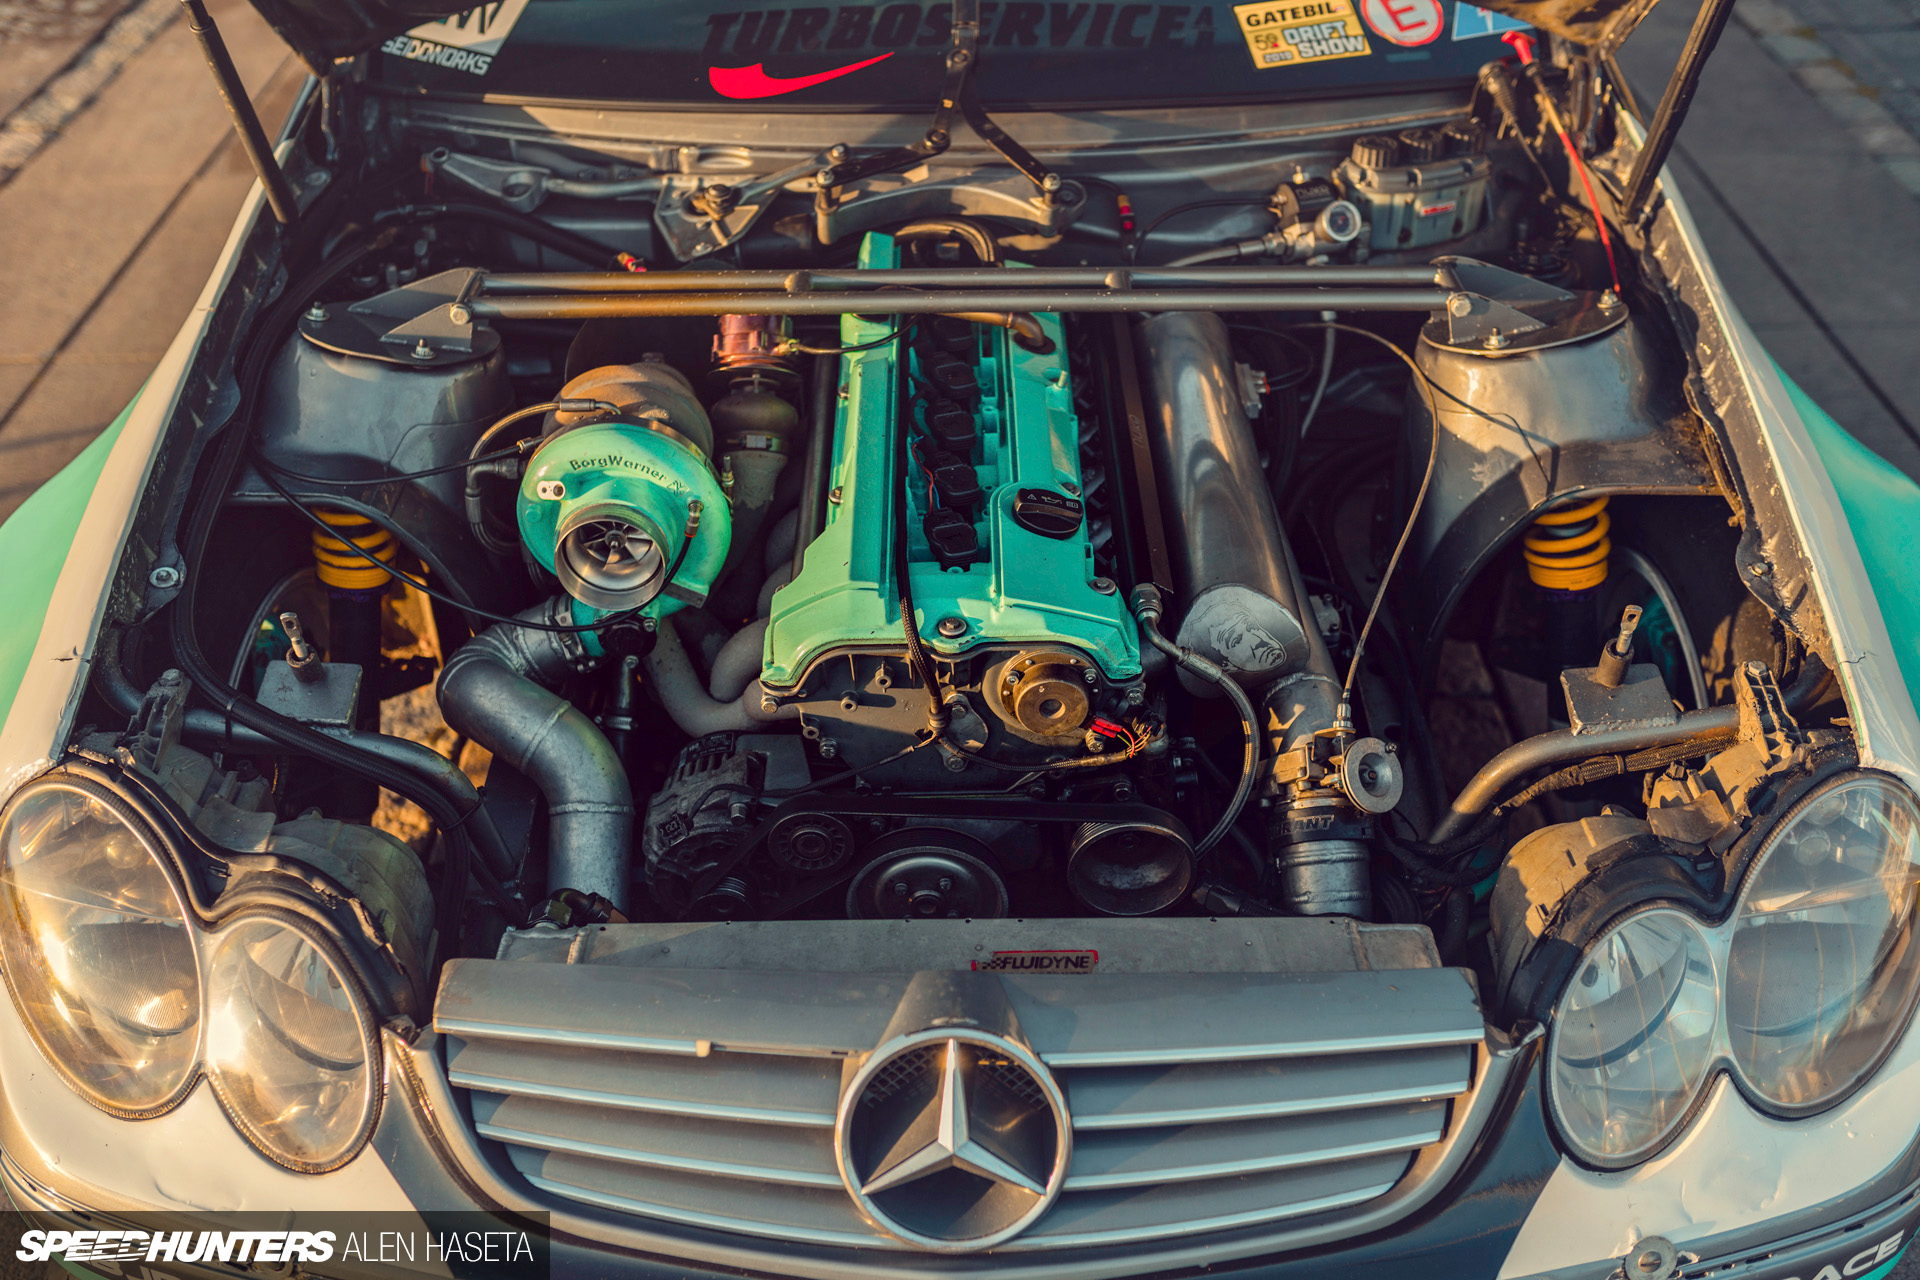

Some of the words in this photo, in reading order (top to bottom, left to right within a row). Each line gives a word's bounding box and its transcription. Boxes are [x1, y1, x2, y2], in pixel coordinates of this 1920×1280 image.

[1246, 2, 1338, 27] GATEBIL
[1379, 0, 1428, 32] E
[1282, 20, 1346, 45] DRIFT
[1297, 36, 1365, 58] SHOW
[569, 454, 667, 481] BorgWarner
[1002, 955, 1091, 970] FLUIDYNE
